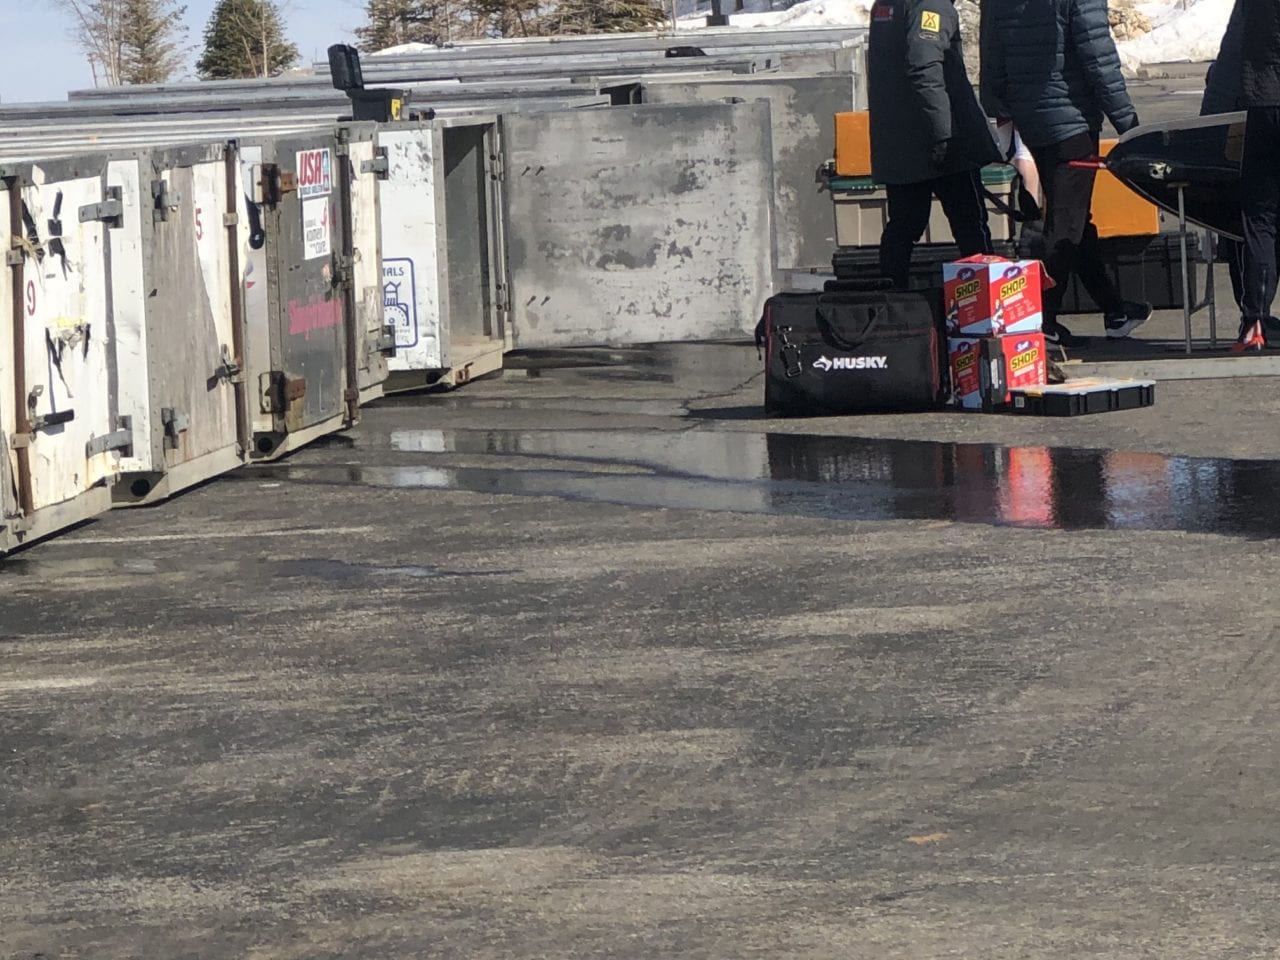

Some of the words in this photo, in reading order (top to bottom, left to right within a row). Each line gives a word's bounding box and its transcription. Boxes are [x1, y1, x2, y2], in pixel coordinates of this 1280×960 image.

[300, 151, 322, 186] USA
[955, 281, 981, 297] SHOP
[1000, 277, 1026, 297] SHOP
[955, 354, 975, 369] SHOP
[1010, 349, 1038, 370] SHOP
